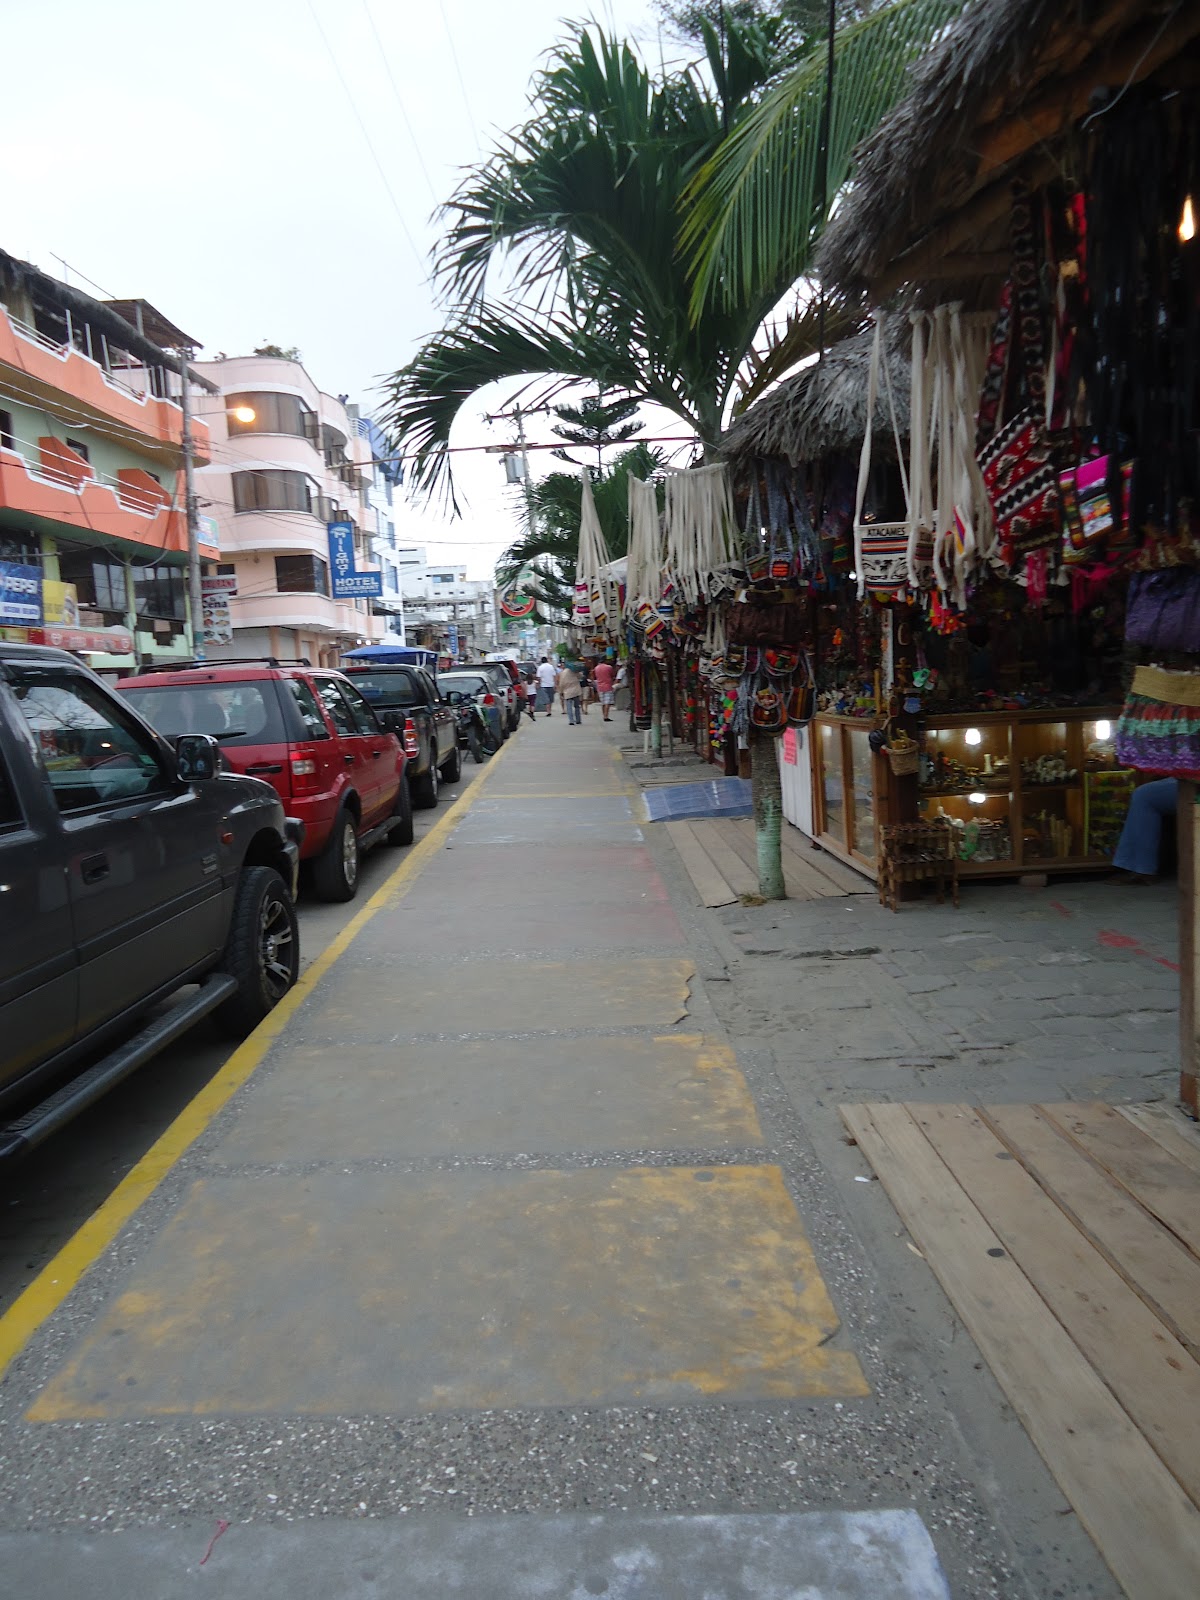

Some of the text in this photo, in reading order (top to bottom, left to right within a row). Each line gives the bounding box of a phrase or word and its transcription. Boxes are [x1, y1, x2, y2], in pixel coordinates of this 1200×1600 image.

[867, 527, 906, 537] ATACAMES
[5, 575, 38, 594] PEPSI
[335, 577, 379, 587] HOTEL
